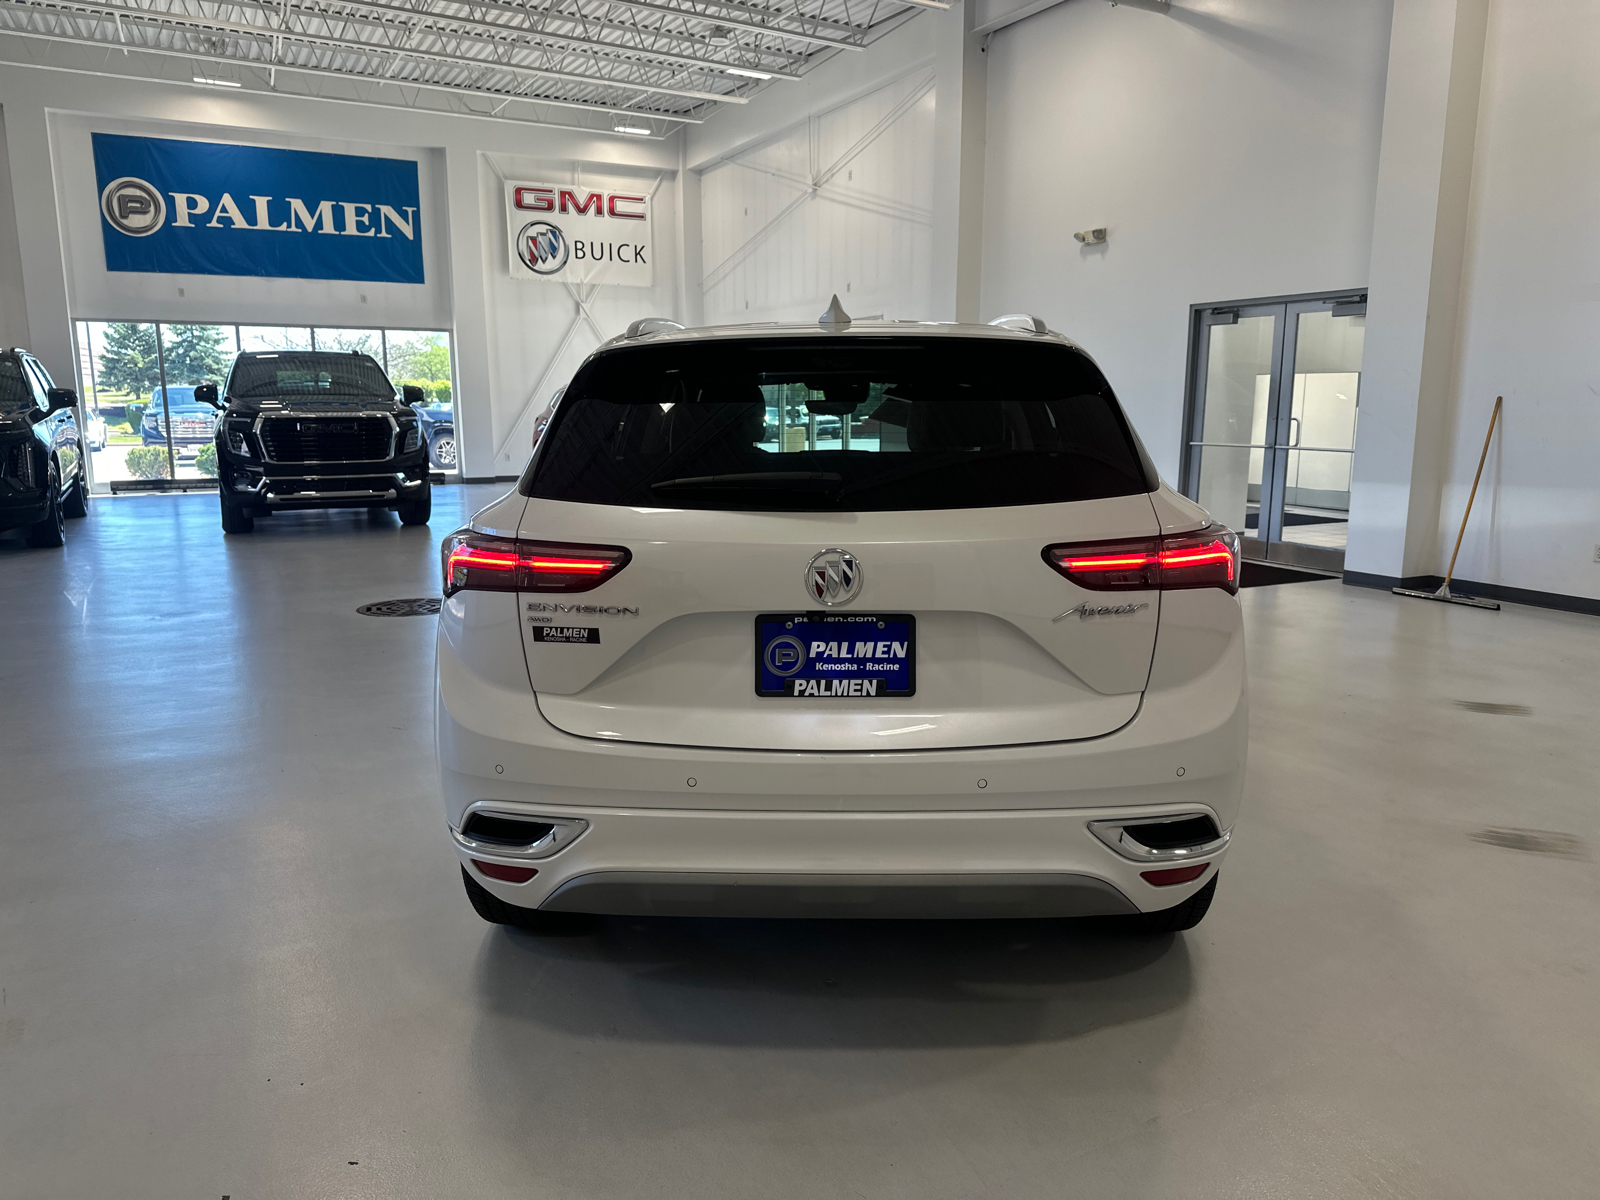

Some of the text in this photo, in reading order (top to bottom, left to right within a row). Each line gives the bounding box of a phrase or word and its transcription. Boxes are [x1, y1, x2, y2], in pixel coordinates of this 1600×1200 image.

[513, 185, 647, 221] GMC
[168, 192, 417, 240] PALMEN
[574, 240, 647, 264] BUICK
[527, 602, 640, 616] ENVISION
[794, 616, 877, 624] paen.com
[543, 627, 588, 638] PALMEN
[809, 641, 908, 658] PALMEN
[816, 662, 858, 671] Kenosha
[866, 662, 900, 671] Racine
[793, 679, 877, 696] PALMEN
